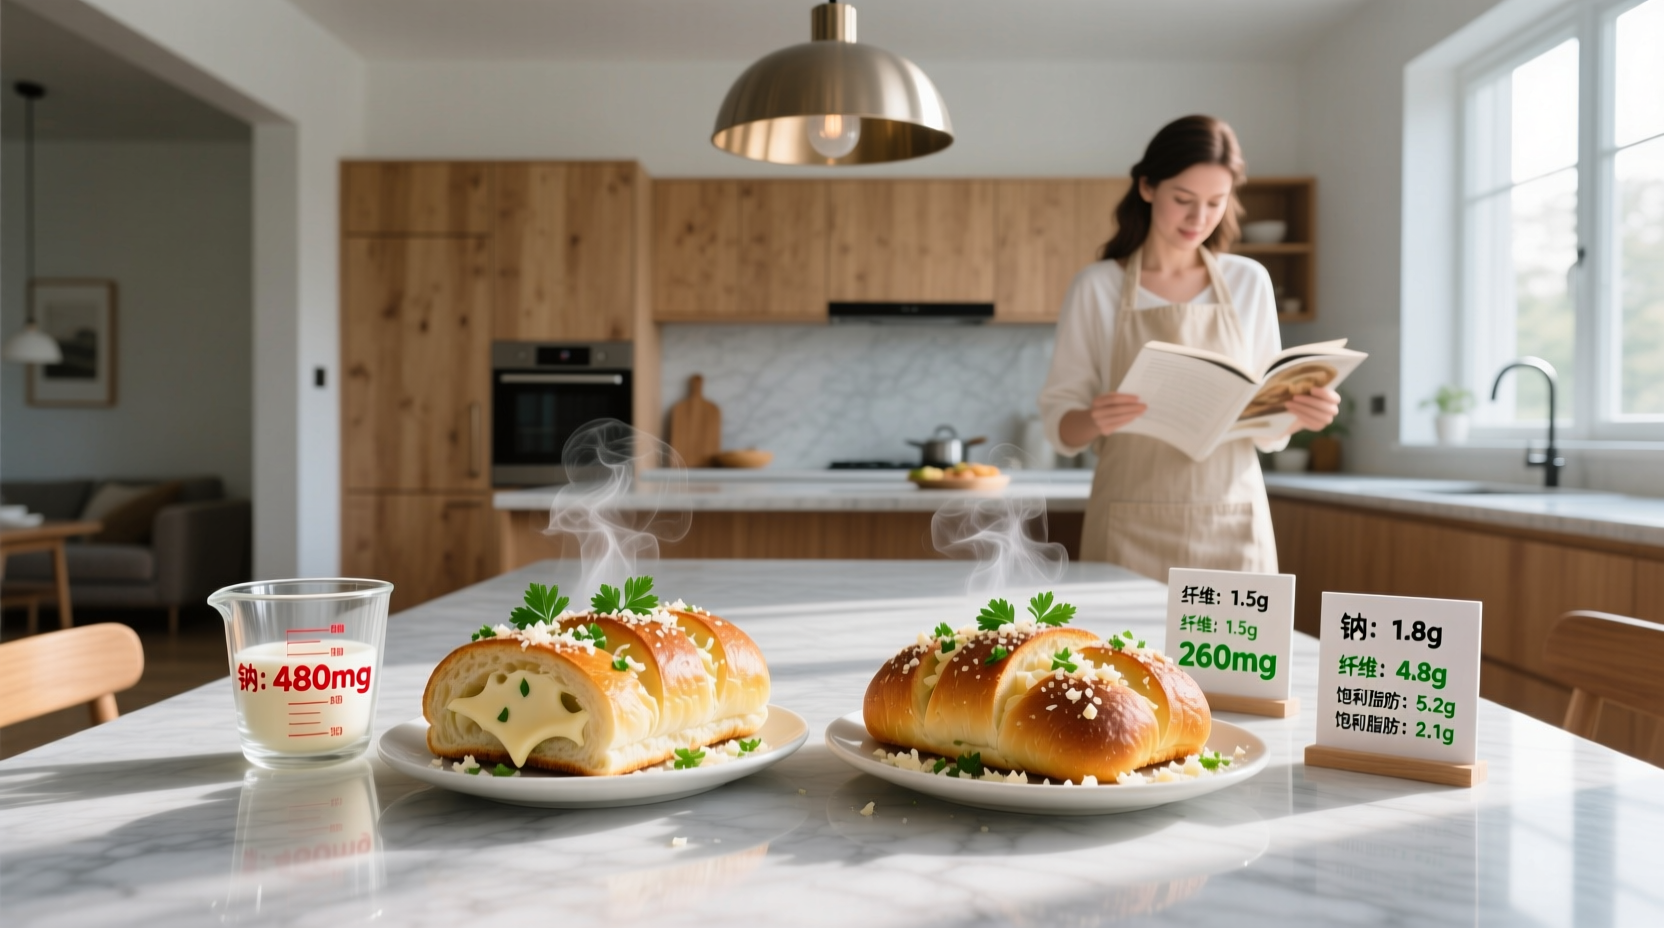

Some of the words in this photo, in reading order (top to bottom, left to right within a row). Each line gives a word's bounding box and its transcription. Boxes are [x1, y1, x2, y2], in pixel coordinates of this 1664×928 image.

[1230, 589, 1269, 612] 1.5g
[1226, 619, 1258, 641] 1.5g
[1392, 619, 1443, 649] 1.8g
[1178, 640, 1277, 681] 260mg
[1395, 659, 1447, 690] 4.8g
[272, 663, 372, 694] 480mg
[1416, 694, 1456, 719] 5.2g
[1415, 720, 1455, 746] 2.1g
